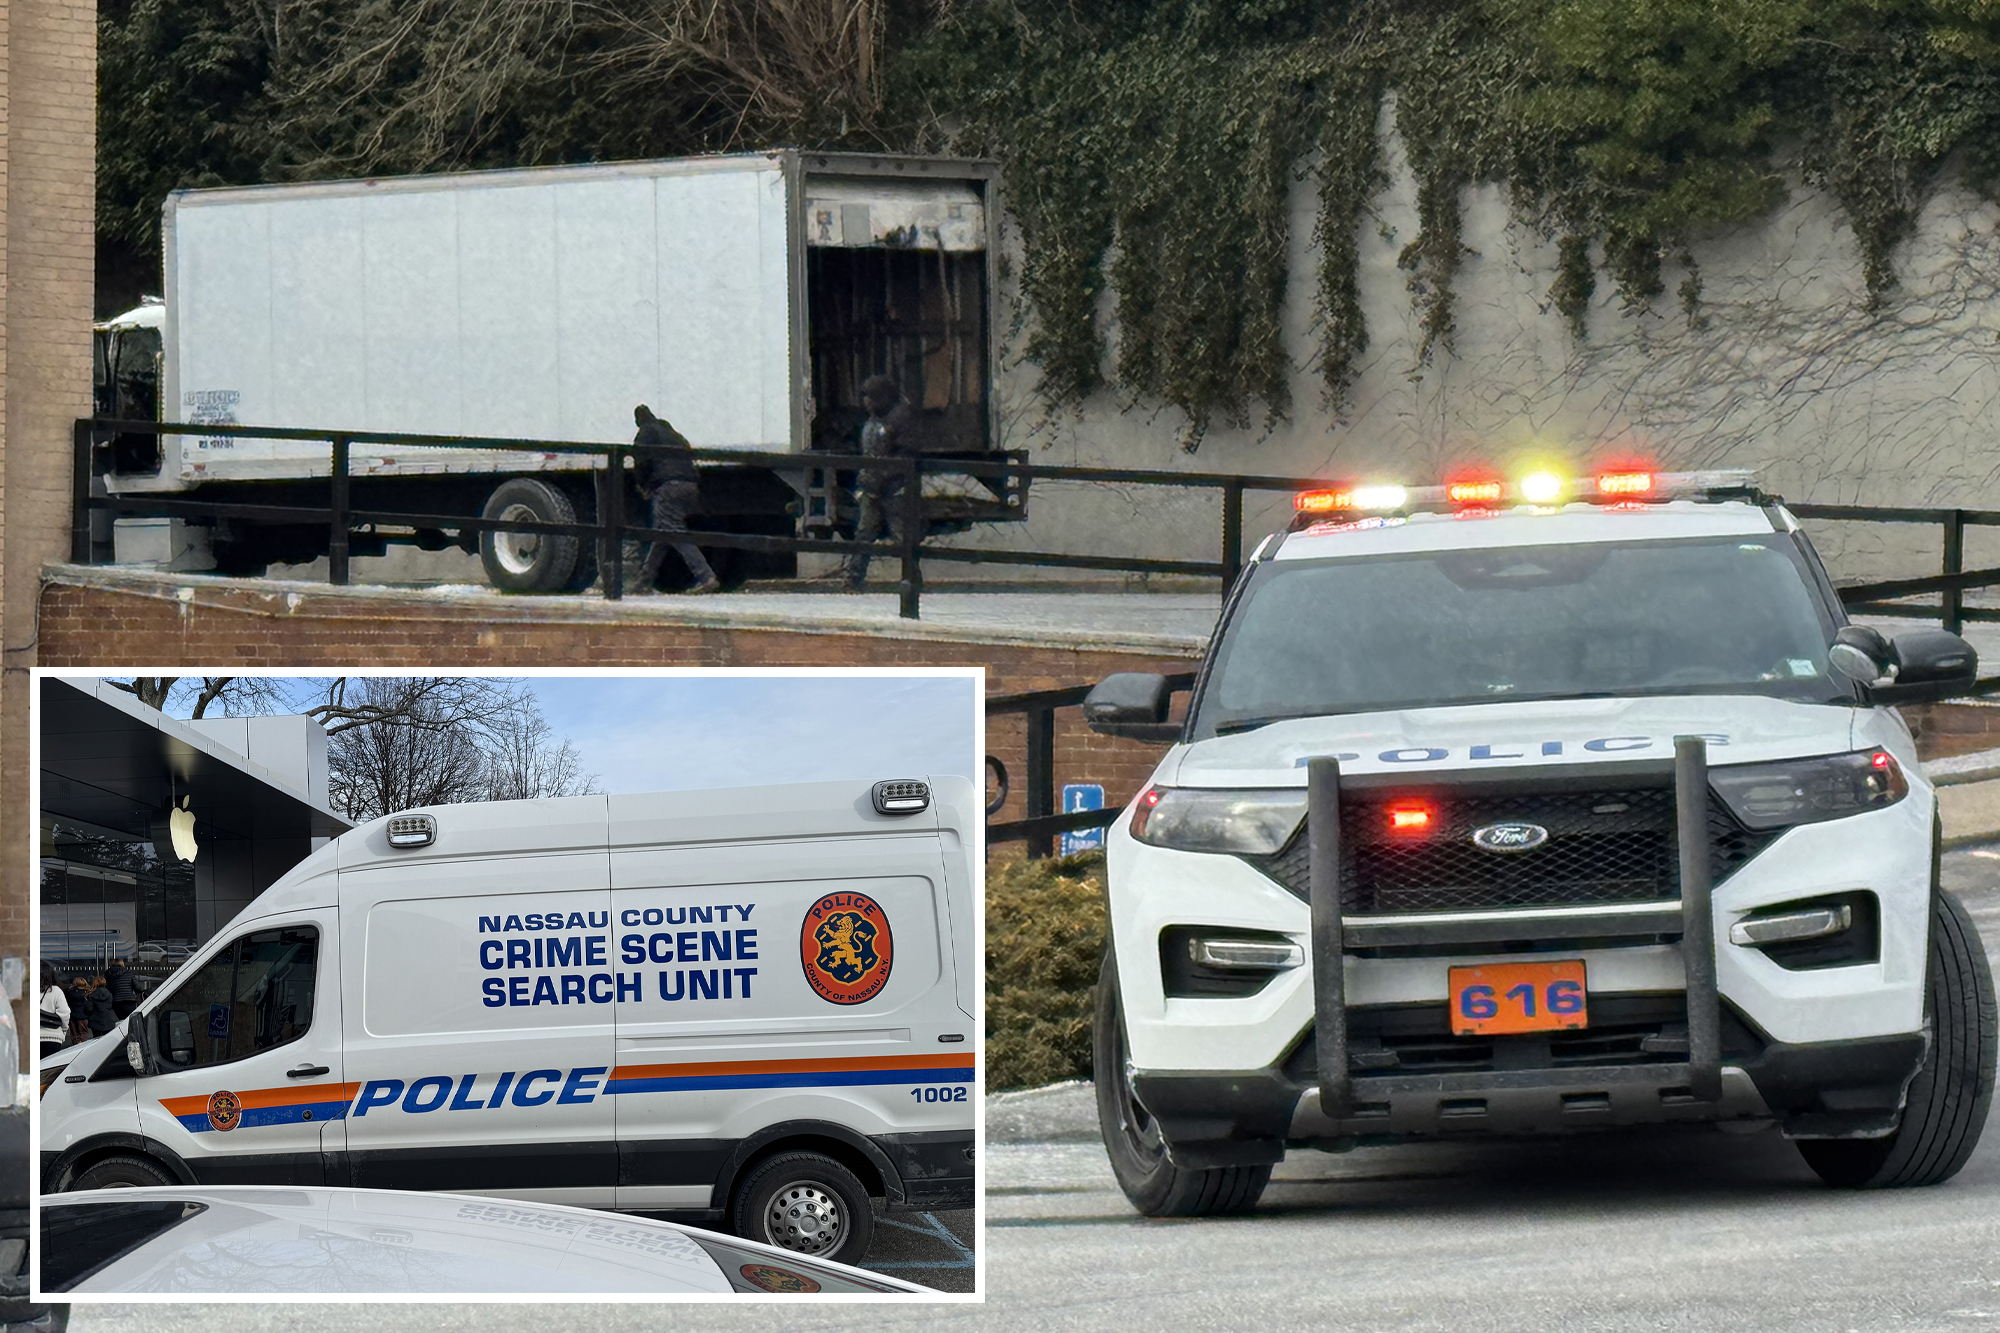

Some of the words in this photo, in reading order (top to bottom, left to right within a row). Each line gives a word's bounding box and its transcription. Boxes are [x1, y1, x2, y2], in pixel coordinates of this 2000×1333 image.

[1490, 827, 1530, 845] Ford
[478, 910, 608, 933] NASSAU
[621, 904, 756, 927] COUNTY
[812, 895, 876, 919] POLICE
[479, 936, 607, 970] CRIME
[621, 929, 758, 964] SCENE
[482, 973, 642, 1007] SEARCH
[659, 968, 757, 1001] UNIT
[806, 962, 832, 995] COUNTY
[879, 958, 889, 976] N.Y.
[1461, 980, 1582, 1019] 616
[213, 1092, 236, 1101] POLICE
[352, 1066, 609, 1117] POLICE
[910, 1086, 968, 1103] 1002
